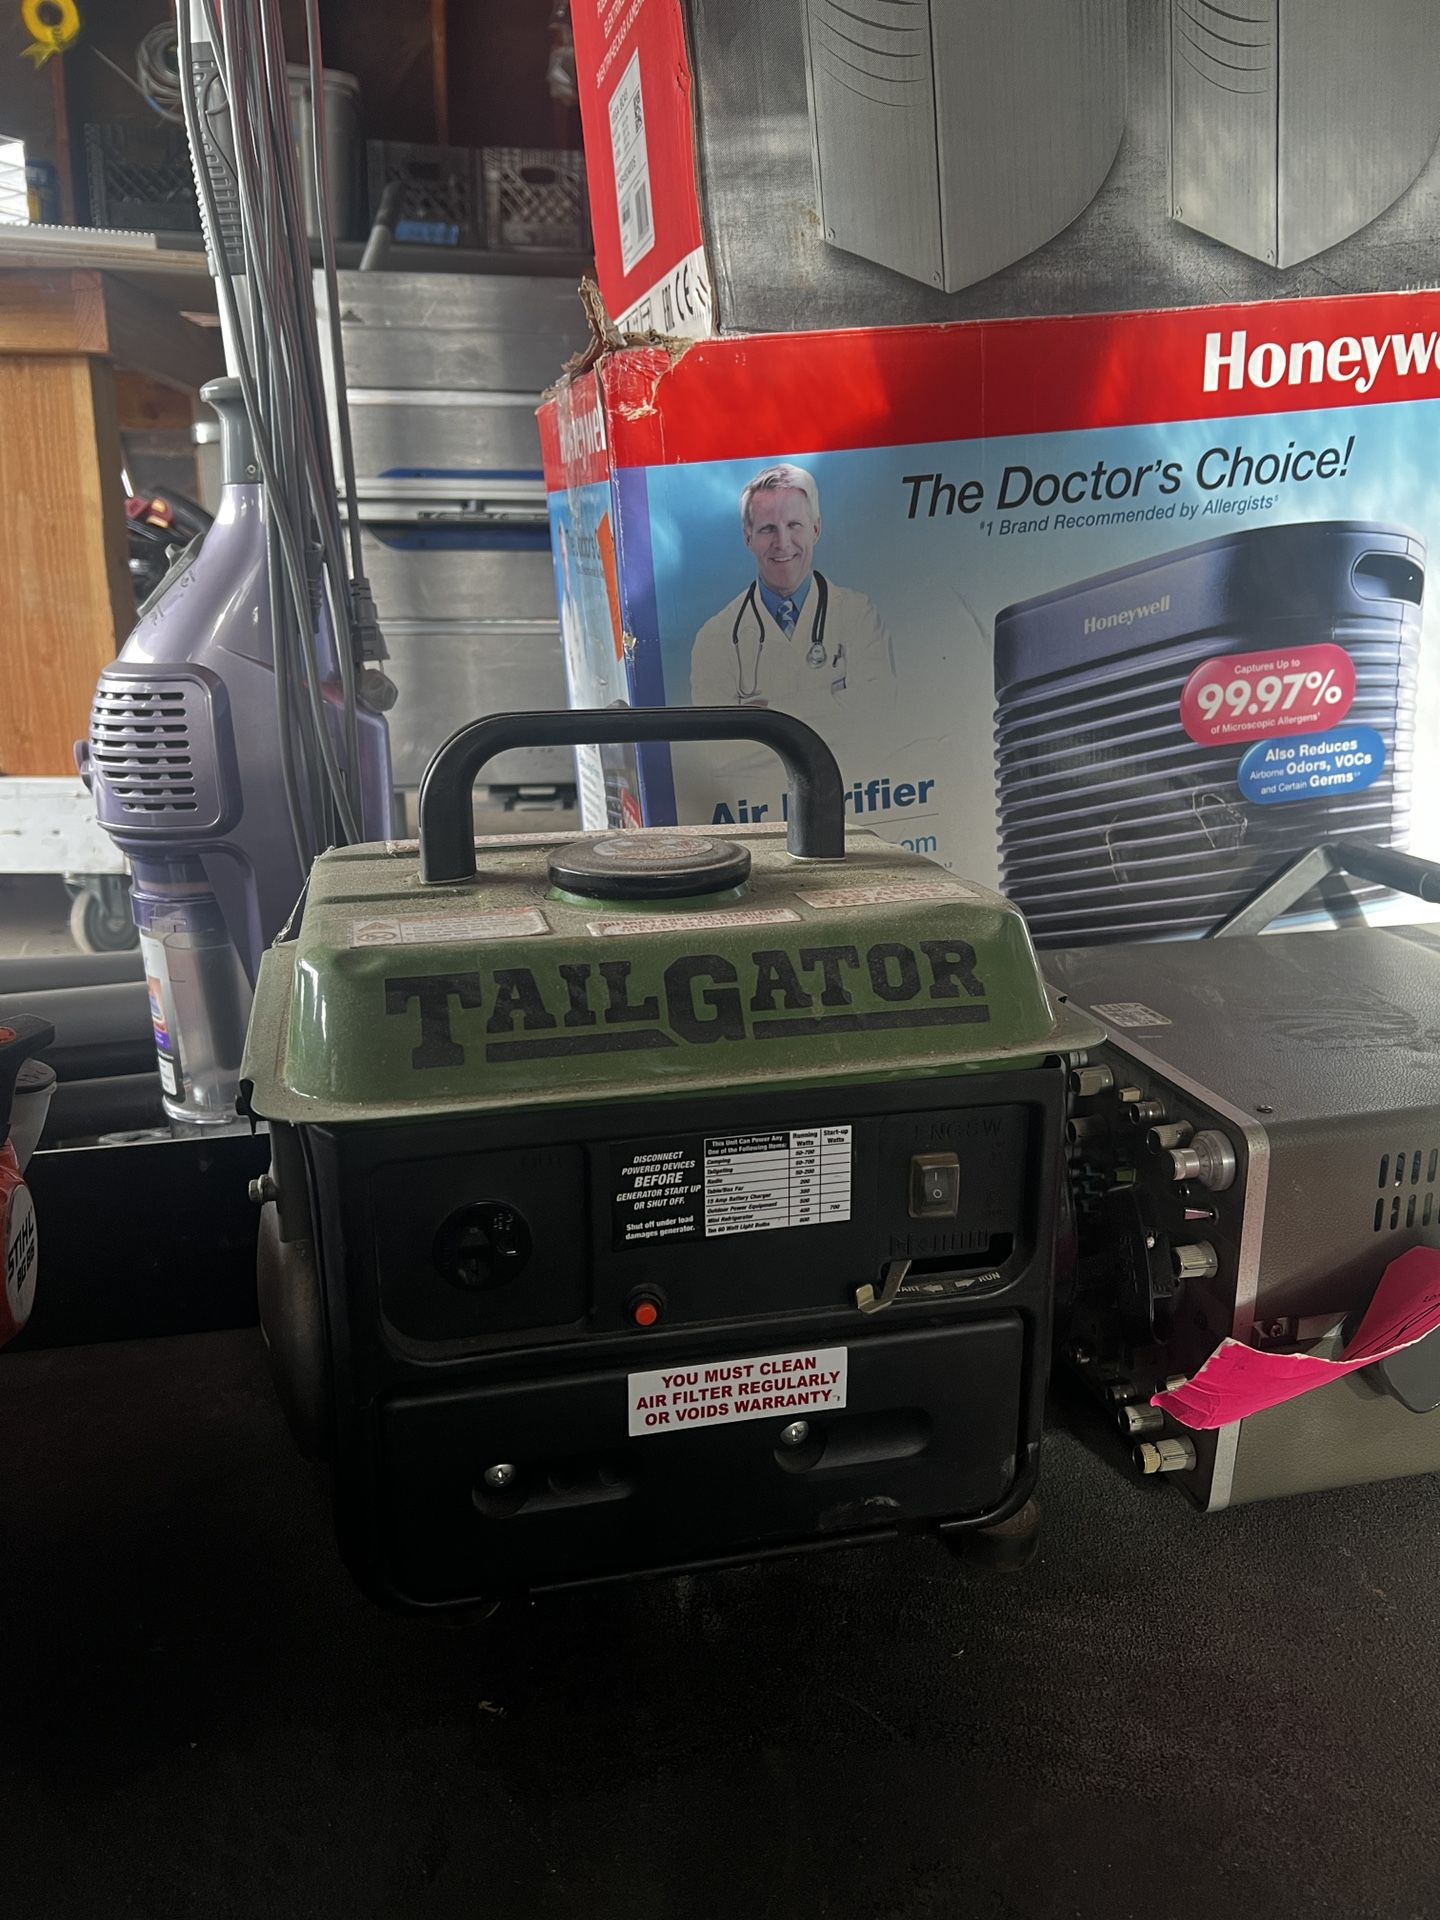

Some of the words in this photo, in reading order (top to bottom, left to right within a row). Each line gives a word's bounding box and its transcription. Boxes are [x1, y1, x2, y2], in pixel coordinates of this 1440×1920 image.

[1203, 330, 1440, 394] Honeyw
[902, 474, 984, 520] The
[997, 459, 1182, 511] Doctor's
[1197, 436, 1356, 491] Choice!
[1000, 516, 1050, 536] Brand
[1054, 504, 1177, 530] Recommended
[1180, 502, 1199, 520] by
[1083, 594, 1171, 635] Honeywell
[1234, 663, 1275, 676] Captures
[1276, 660, 1290, 671] Up
[1291, 658, 1301, 668] to
[1197, 669, 1342, 720] 99.97%
[1210, 726, 1221, 735] of
[1222, 718, 1276, 734] Microscopic
[1265, 748, 1295, 762] Also
[1299, 740, 1358, 758] Reduces
[1250, 769, 1284, 781] Airborne
[1286, 760, 1331, 776] Odors,
[1335, 752, 1372, 769] VOCs
[1260, 784, 1277, 795] and
[1278, 780, 1307, 791] Certain
[711, 800, 768, 825] Air
[783, 779, 935, 824] rifier
[739, 1137, 751, 1145] Can
[752, 1135, 770, 1144] Power
[771, 1135, 784, 1143] Any
[792, 1131, 819, 1140] Running
[823, 1128, 849, 1138] Start-up
[827, 1137, 846, 1145] Watts
[708, 1148, 720, 1156] One
[729, 1146, 738, 1154] the
[739, 1143, 768, 1153] Following
[796, 1140, 815, 1148] Watts
[633, 1151, 684, 1164] DISCONNECT
[621, 1163, 660, 1176] POWERED
[662, 1160, 696, 1171] DEVICES
[634, 1171, 684, 1188] BEFORE
[616, 1188, 663, 1202] GENERATOR
[664, 1186, 690, 1196] START
[690, 1184, 702, 1193] UP
[715, 1197, 728, 1205] Amp
[750, 1192, 772, 1202] Charger
[634, 1201, 645, 1210] OR
[647, 1198, 668, 1209] SHUT
[669, 1196, 686, 1206] OFF.
[730, 1204, 748, 1212] Power
[749, 1201, 778, 1211] Equipment
[829, 1203, 841, 1212] 700
[626, 1222, 643, 1231] Shut
[645, 1220, 655, 1229] off
[656, 1218, 676, 1227] under
[678, 1215, 694, 1224] load
[625, 1230, 659, 1240] damages
[660, 1225, 696, 1237] generator.
[8, 1206, 34, 1284] STIHL
[978, 1270, 1001, 1284] RUN
[662, 1374, 699, 1389] YOU
[704, 1365, 755, 1382] MUST
[759, 1356, 817, 1376] CLEAN
[636, 1394, 667, 1410] AIR
[672, 1386, 733, 1405] FILTER
[738, 1371, 841, 1396] REGULARLY
[645, 1411, 671, 1427] OR
[675, 1403, 729, 1422] VOIDS
